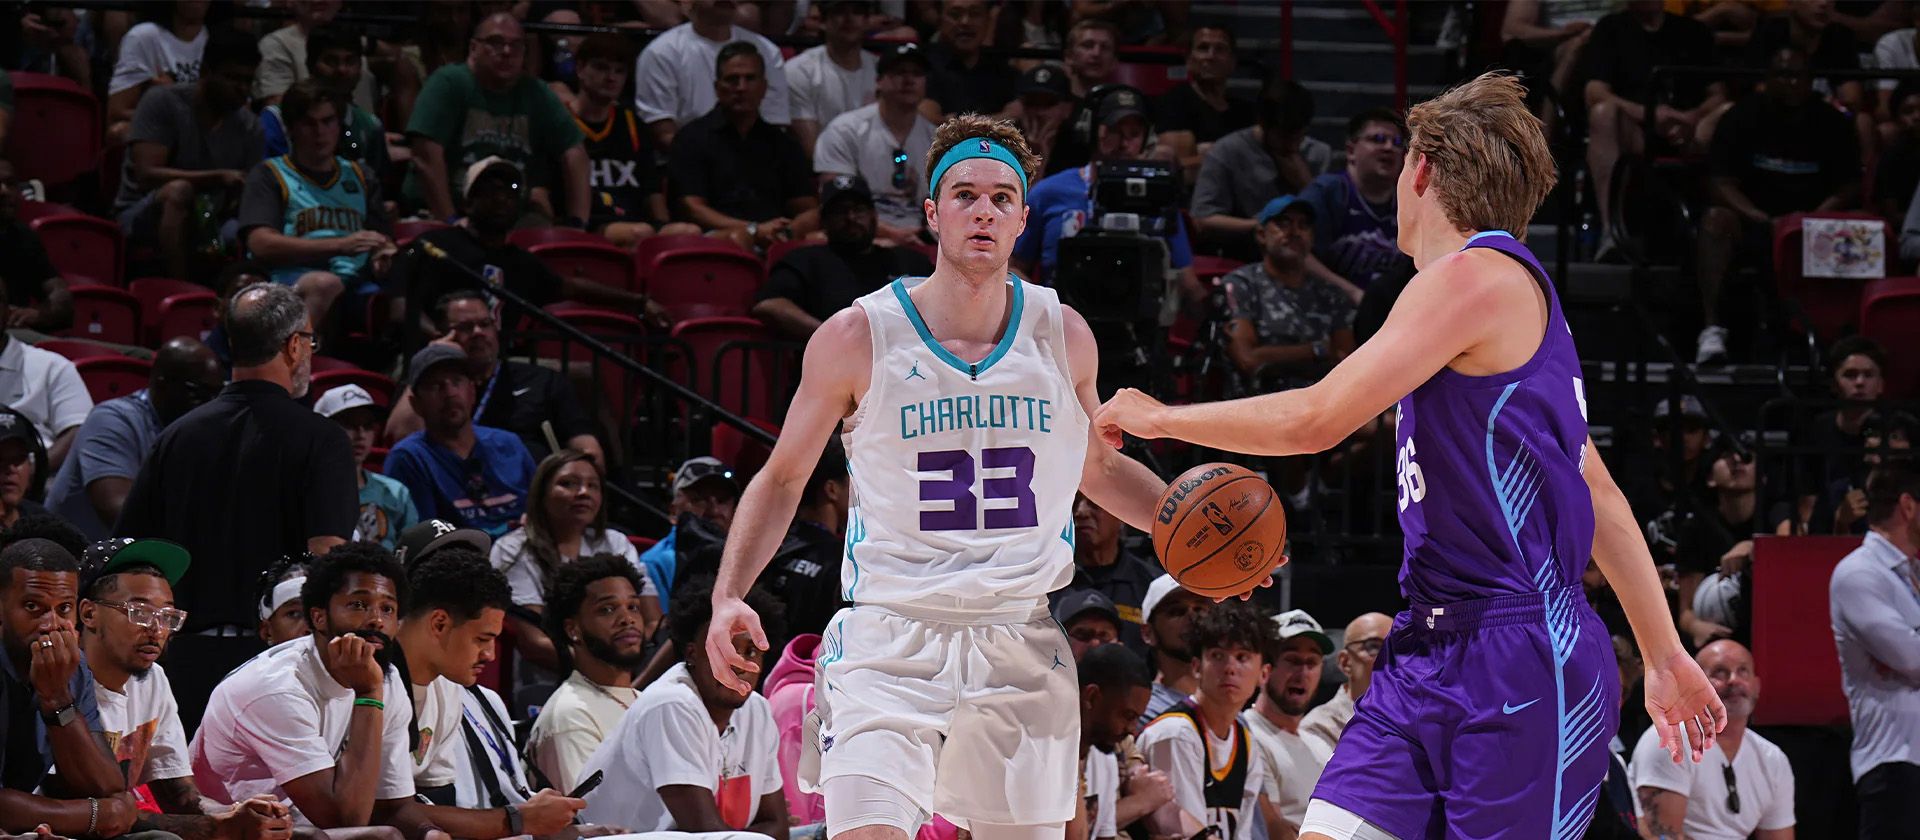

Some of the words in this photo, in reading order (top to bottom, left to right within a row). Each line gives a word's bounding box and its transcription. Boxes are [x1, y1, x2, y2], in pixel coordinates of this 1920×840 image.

[590, 159, 640, 188] HX
[901, 394, 1051, 439] CHARLOTTE
[917, 447, 1039, 531] 33
[1158, 466, 1232, 525] Wilson
[1397, 435, 1427, 513] 36
